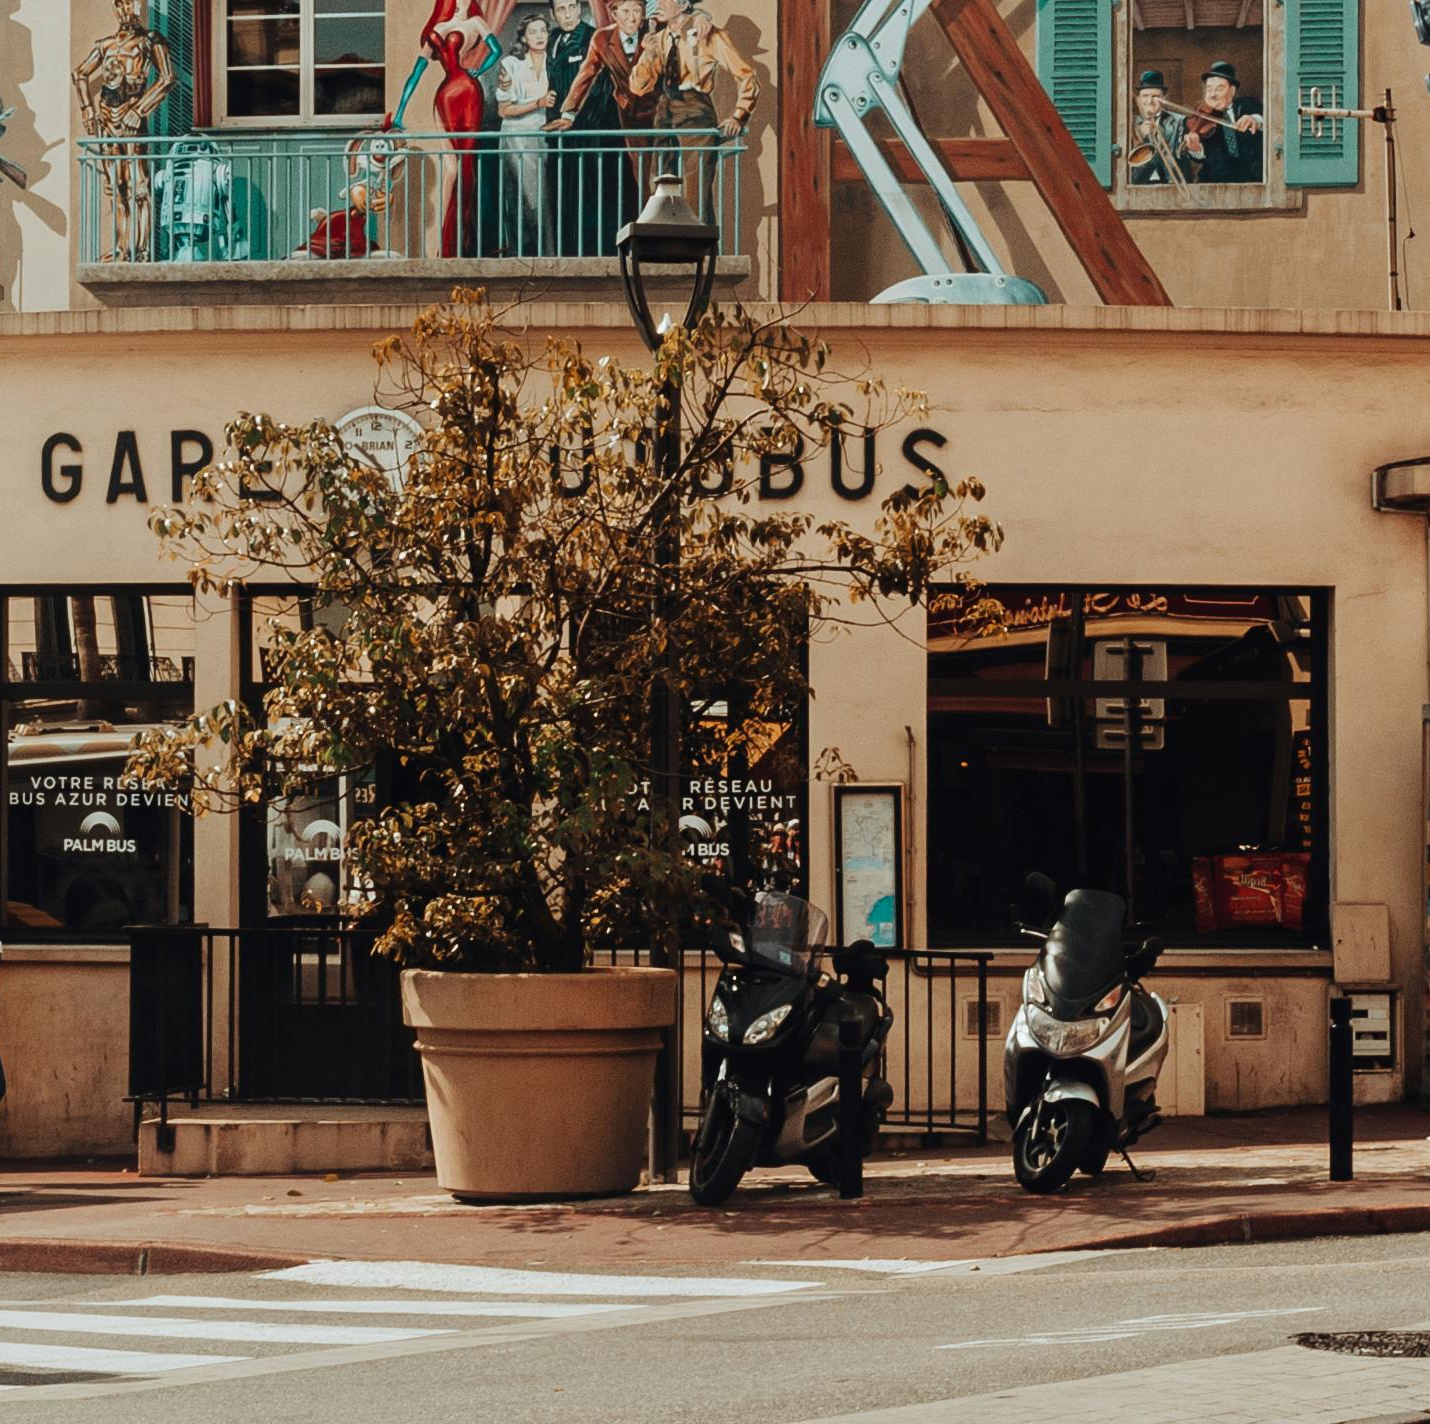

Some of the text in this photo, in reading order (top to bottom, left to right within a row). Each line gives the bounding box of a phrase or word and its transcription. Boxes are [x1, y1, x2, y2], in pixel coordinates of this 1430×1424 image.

[371, 421, 382, 431] 12
[40, 429, 283, 504] GARE
[31, 776, 94, 790] VOTRE
[690, 776, 773, 794] RÉSEAU
[9, 792, 189, 807] BUS AZUR DEVIEN
[704, 795, 797, 811] DEVIENT
[63, 838, 136, 853] PALM BUS
[697, 843, 730, 857] BUS
[285, 847, 328, 861] PALM
